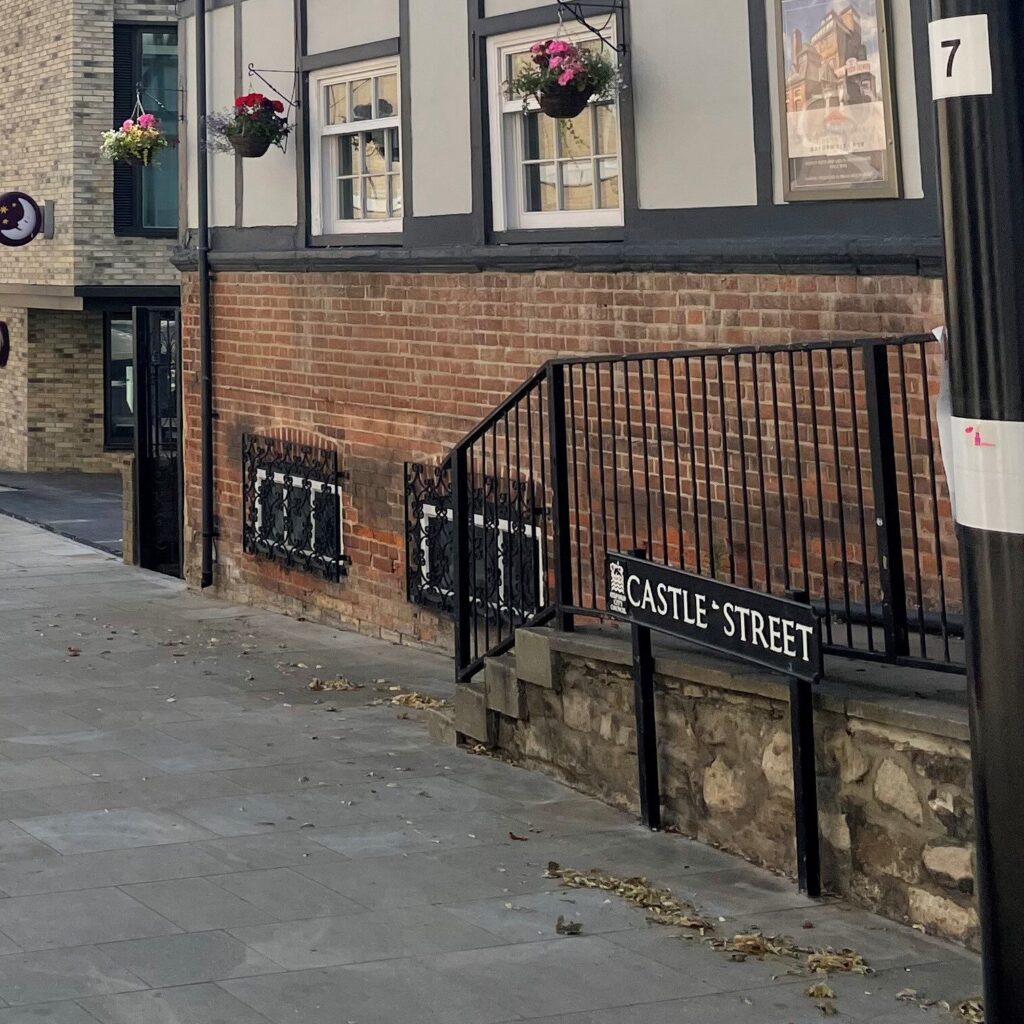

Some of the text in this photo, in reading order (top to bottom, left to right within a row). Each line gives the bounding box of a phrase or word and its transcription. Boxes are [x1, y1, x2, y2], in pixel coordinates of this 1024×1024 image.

[940, 38, 962, 78] 7
[626, 574, 814, 662] CASTLE STREET
